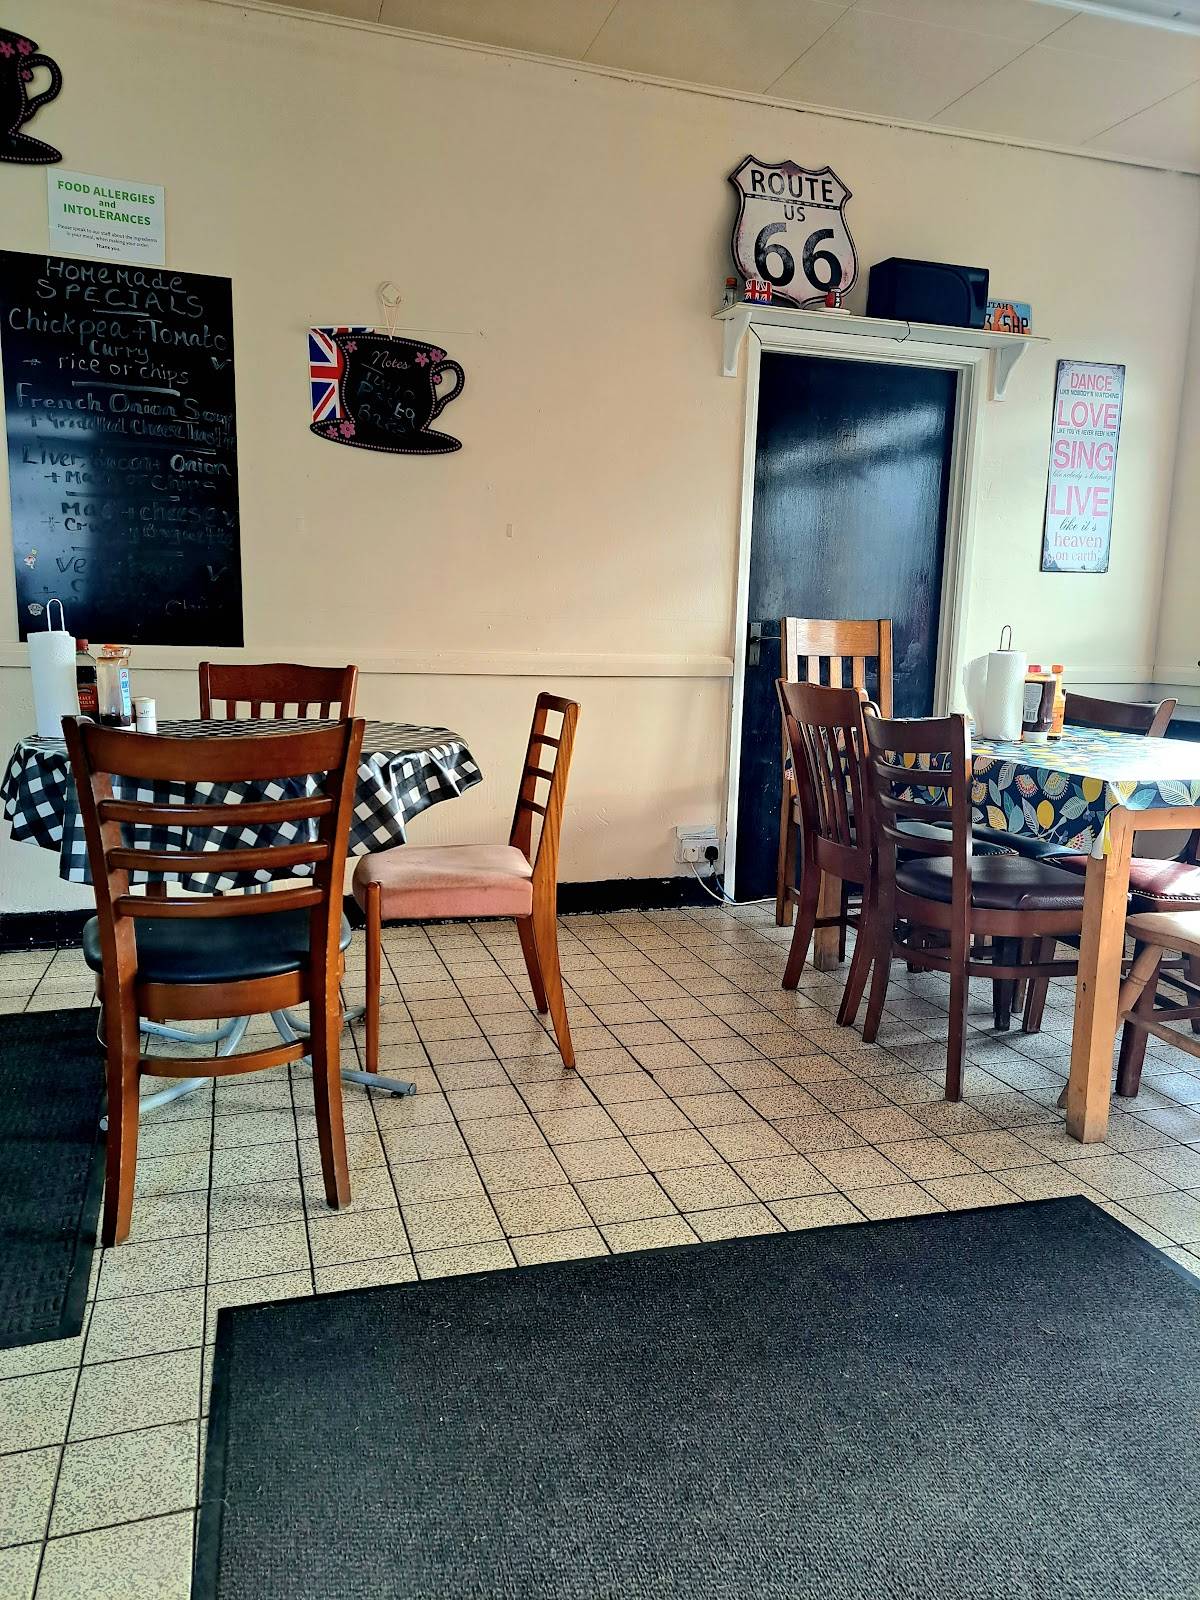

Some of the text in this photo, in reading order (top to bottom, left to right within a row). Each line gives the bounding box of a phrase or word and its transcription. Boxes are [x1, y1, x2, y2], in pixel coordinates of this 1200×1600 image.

[57, 180, 156, 205] FOOD ALLERGIES
[750, 169, 834, 203] ROUTE
[63, 203, 151, 226] INTOLERANCES
[98, 200, 116, 209] and
[783, 204, 806, 222] US
[754, 222, 843, 293] 66
[36, 279, 204, 318] SPECIALS
[8, 307, 130, 345] Chickpea
[58, 353, 101, 374] rice
[140, 362, 190, 389] chips
[1070, 372, 1113, 391] DANCE
[16, 382, 104, 412] French
[1057, 399, 1119, 429] LOVE
[170, 453, 232, 477] Onion
[1053, 439, 1114, 472] SING
[1050, 484, 1110, 516] LIVE
[1053, 532, 1102, 549] heaven
[1055, 551, 1068, 561] on
